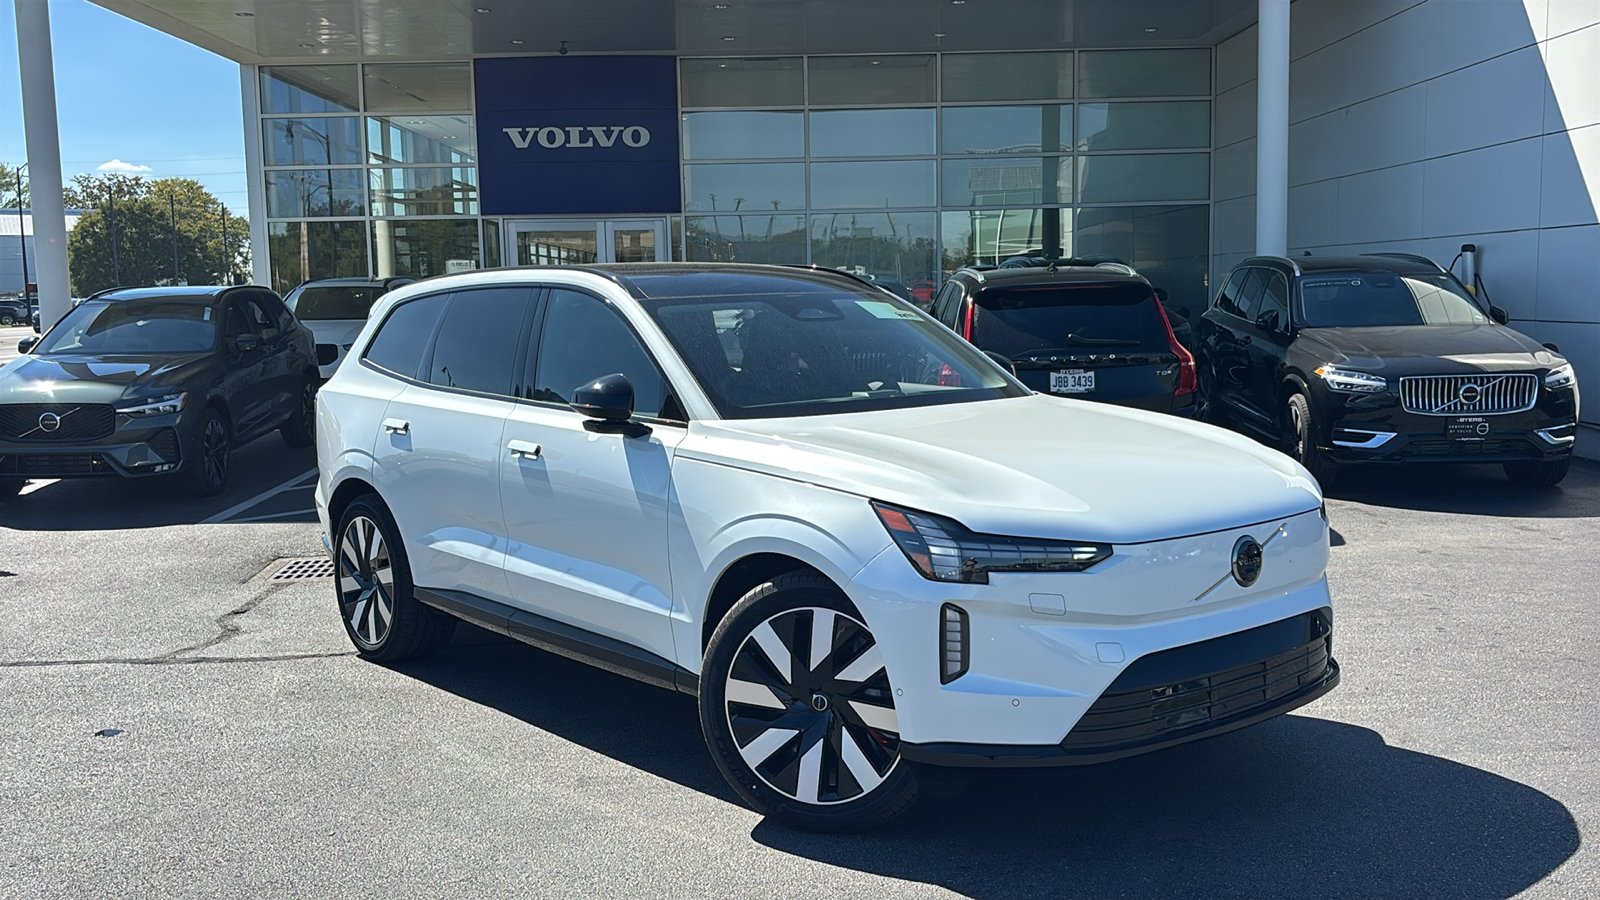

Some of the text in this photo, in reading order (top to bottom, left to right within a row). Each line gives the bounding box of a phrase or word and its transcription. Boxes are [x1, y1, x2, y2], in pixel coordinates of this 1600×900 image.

[502, 125, 650, 149] VOLVO
[1052, 375, 1093, 388] JBB 3439
[1238, 557, 1260, 566] VOLVO
